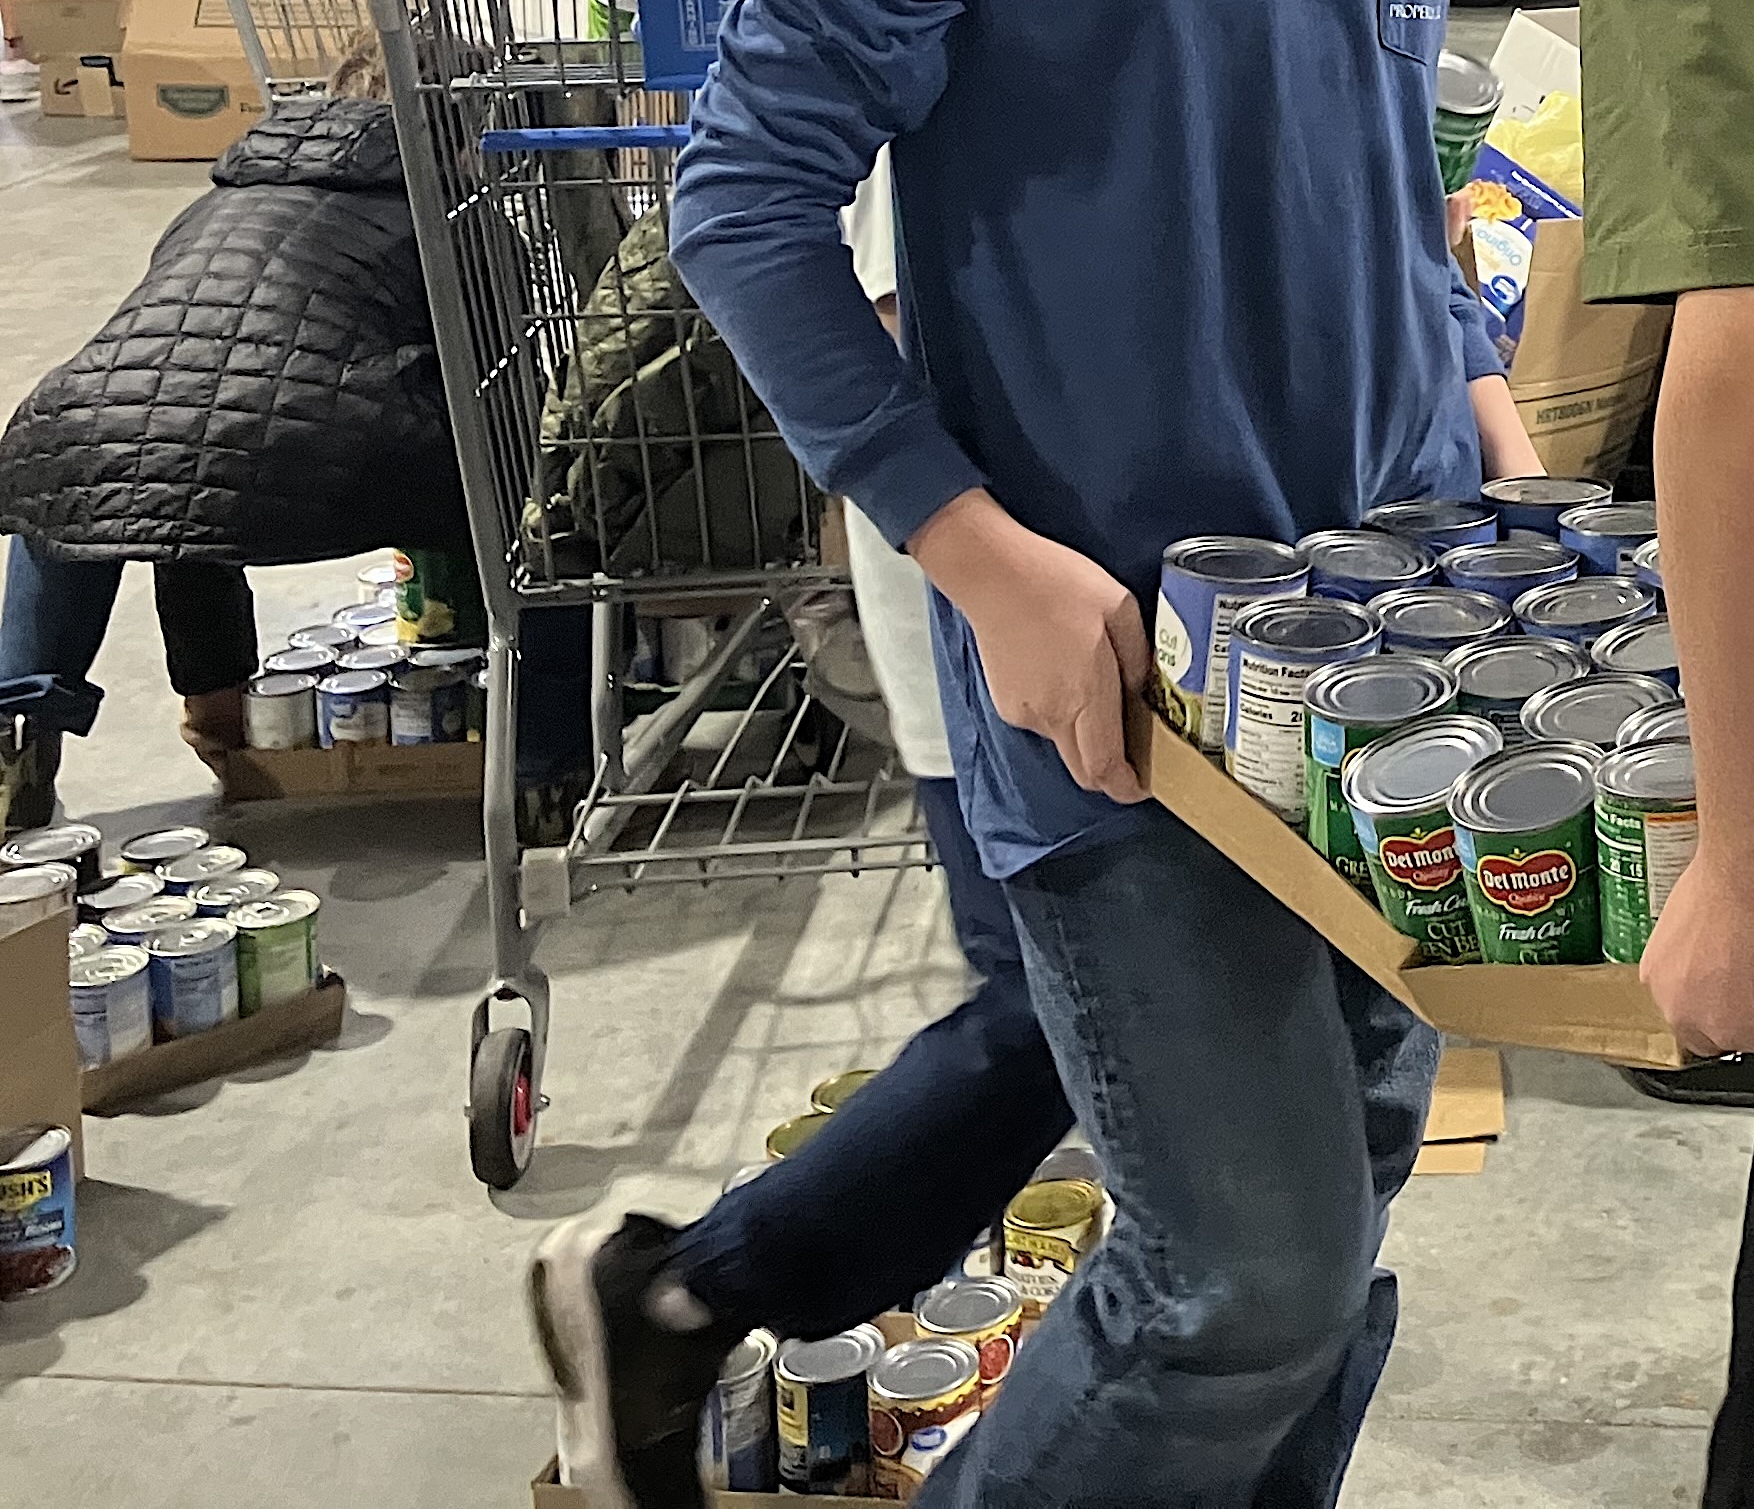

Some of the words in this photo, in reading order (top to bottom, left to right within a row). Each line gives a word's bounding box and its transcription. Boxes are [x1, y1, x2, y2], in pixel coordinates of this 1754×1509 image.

[1242, 658, 1279, 677] Nutrition
[1239, 702, 1273, 721] Calories
[1609, 813, 1642, 830] Facts
[1335, 855, 1369, 877] GRE
[1384, 850, 1413, 869] Del
[1413, 845, 1456, 868] Mon
[1482, 869, 1510, 890] Del
[1510, 864, 1570, 890] Monte
[1629, 863, 1644, 878] 15
[1405, 897, 1443, 917] Fresh
[1427, 919, 1467, 940] CUT
[1499, 922, 1536, 941] Fresh
[1537, 919, 1572, 940] Cut
